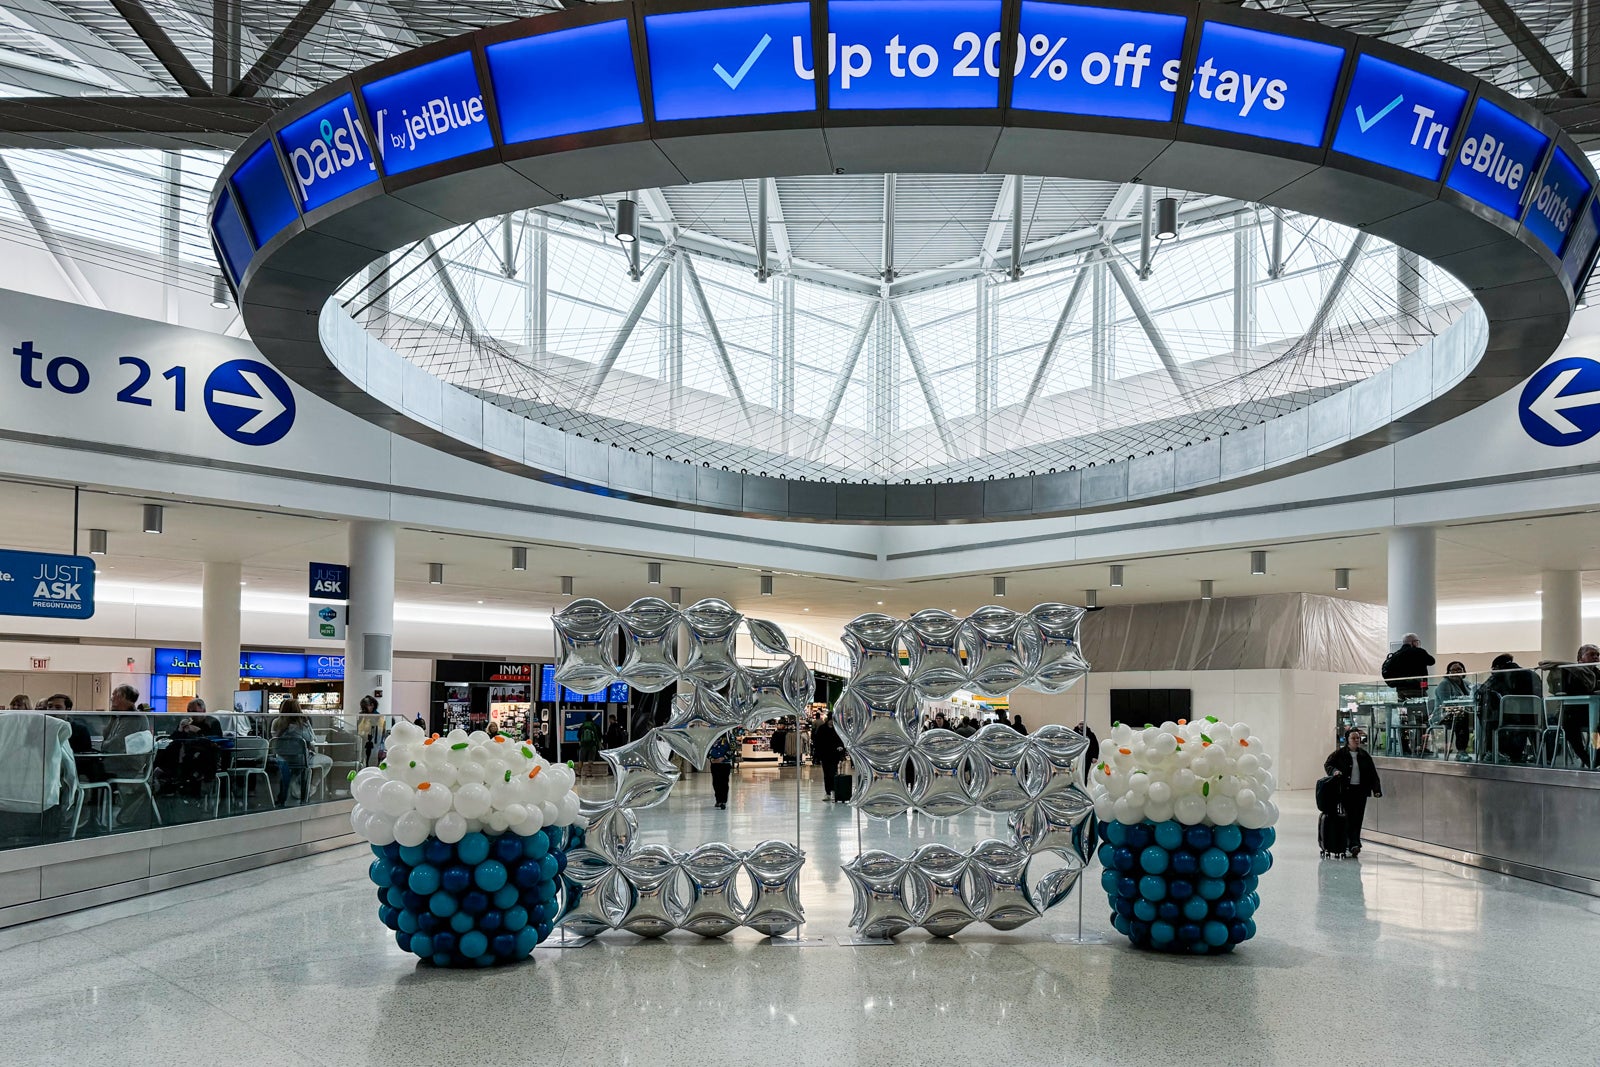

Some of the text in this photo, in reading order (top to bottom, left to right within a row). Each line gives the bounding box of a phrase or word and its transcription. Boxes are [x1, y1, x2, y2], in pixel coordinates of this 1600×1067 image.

[793, 31, 1288, 117] Up to 200% off stays
[289, 96, 483, 202] paisly by jetBlue
[1410, 104, 1524, 190] TrueBlue
[12, 341, 186, 412] to 21
[33, 564, 83, 582] JUST
[314, 569, 342, 581] JUST
[33, 581, 82, 600] ASK
[314, 580, 342, 593] ASK
[33, 659, 47, 669] EXIT
